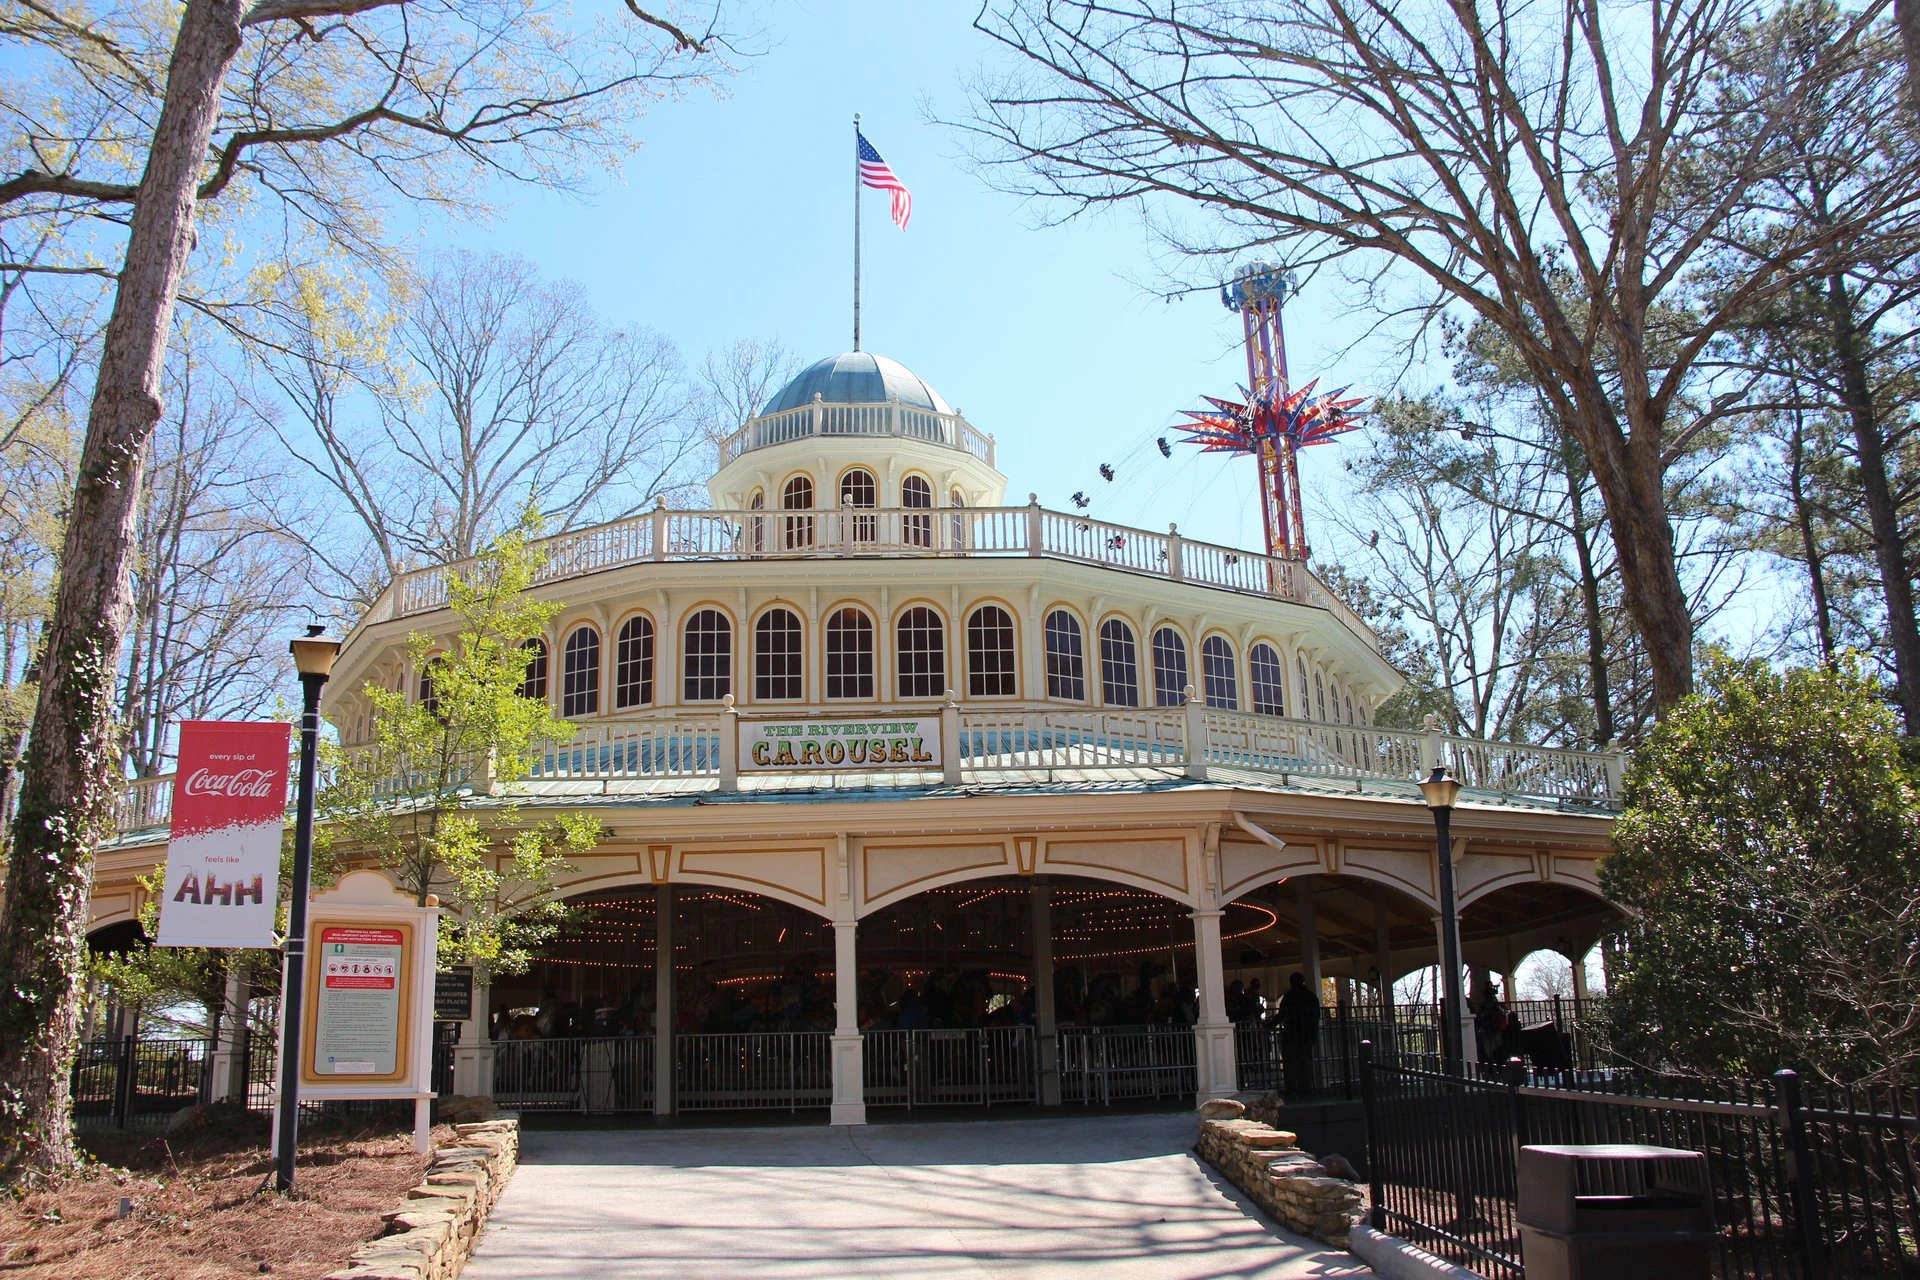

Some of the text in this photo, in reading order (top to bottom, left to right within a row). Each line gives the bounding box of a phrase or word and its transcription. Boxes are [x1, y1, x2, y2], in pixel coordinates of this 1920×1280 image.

[764, 722, 918, 737] THE RIVERVIEW
[233, 753, 245, 761] sip
[247, 753, 256, 761] of
[752, 737, 932, 766] CAROUSEL
[184, 767, 279, 798] Coca-Cola
[173, 871, 263, 906] AHH
